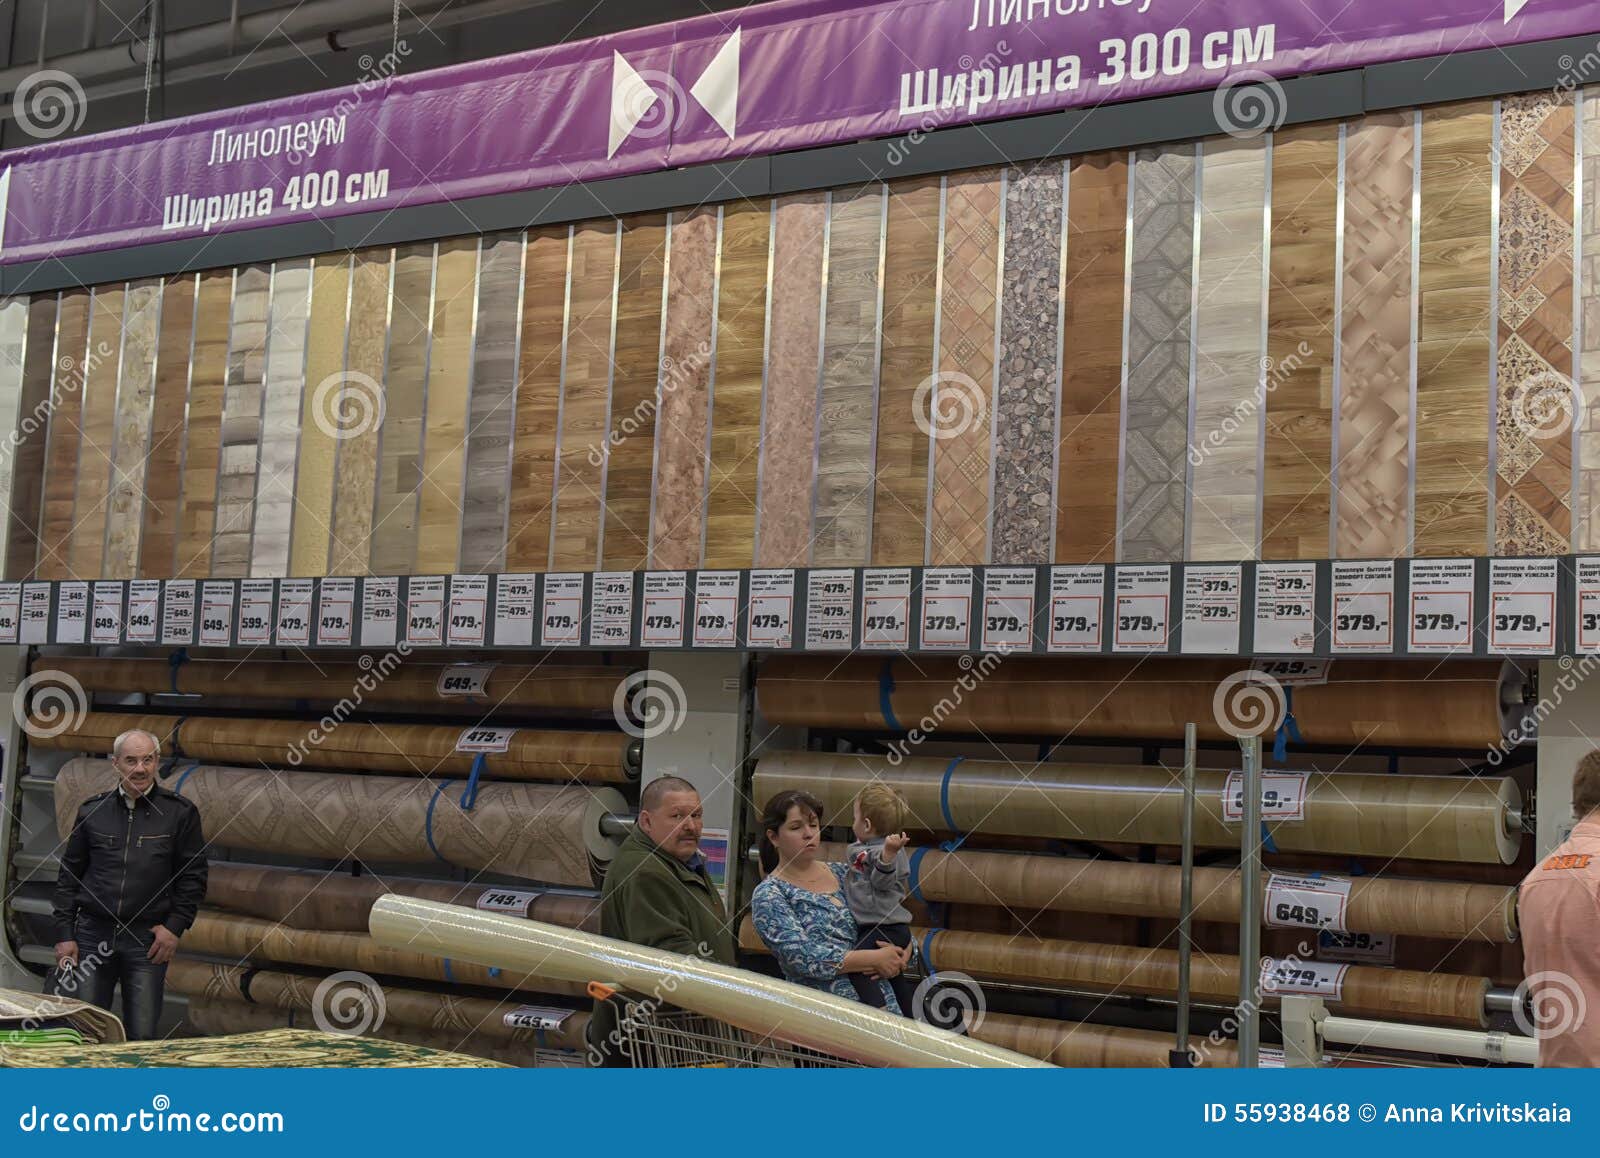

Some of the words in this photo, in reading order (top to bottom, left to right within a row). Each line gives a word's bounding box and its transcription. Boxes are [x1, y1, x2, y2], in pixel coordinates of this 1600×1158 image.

[899, 55, 1081, 116] Ширина
[1098, 28, 1190, 86] 300
[1202, 23, 1276, 71] см
[208, 115, 346, 166] Линолеум
[162, 187, 273, 232] Ширина
[282, 169, 340, 211] 400
[344, 168, 390, 203] см
[823, 583, 850, 593] 479,-
[1204, 580, 1236, 592] 379,-
[1277, 578, 1311, 590] 379,-
[823, 606, 850, 616] 479,-
[1203, 606, 1236, 617] 379,-
[1276, 604, 1310, 616] 379,-
[203, 619, 229, 631] 649,-
[242, 617, 268, 630] 599,-
[280, 618, 307, 630] 479,-
[321, 617, 349, 629] 479,-
[410, 617, 439, 629] 479,-
[452, 616, 482, 628] 479,-
[546, 616, 578, 629] 479,-
[645, 615, 680, 629] 479,-
[698, 615, 733, 629] 479,-
[752, 614, 788, 628] 479,-
[866, 616, 904, 630] 479,-
[926, 616, 965, 631] 379,-
[987, 616, 1028, 632] 379,-
[1054, 616, 1097, 632] 379,-
[1119, 615, 1164, 631] 379,-
[1337, 614, 1388, 631] 379,-
[1415, 614, 1467, 631] 379,-
[1495, 614, 1550, 632] 379,-
[822, 629, 848, 640] 479,-
[443, 677, 478, 691] 649,-
[467, 731, 502, 743] 479,-
[485, 893, 522, 906] 749,-
[1276, 903, 1332, 926] 649,-
